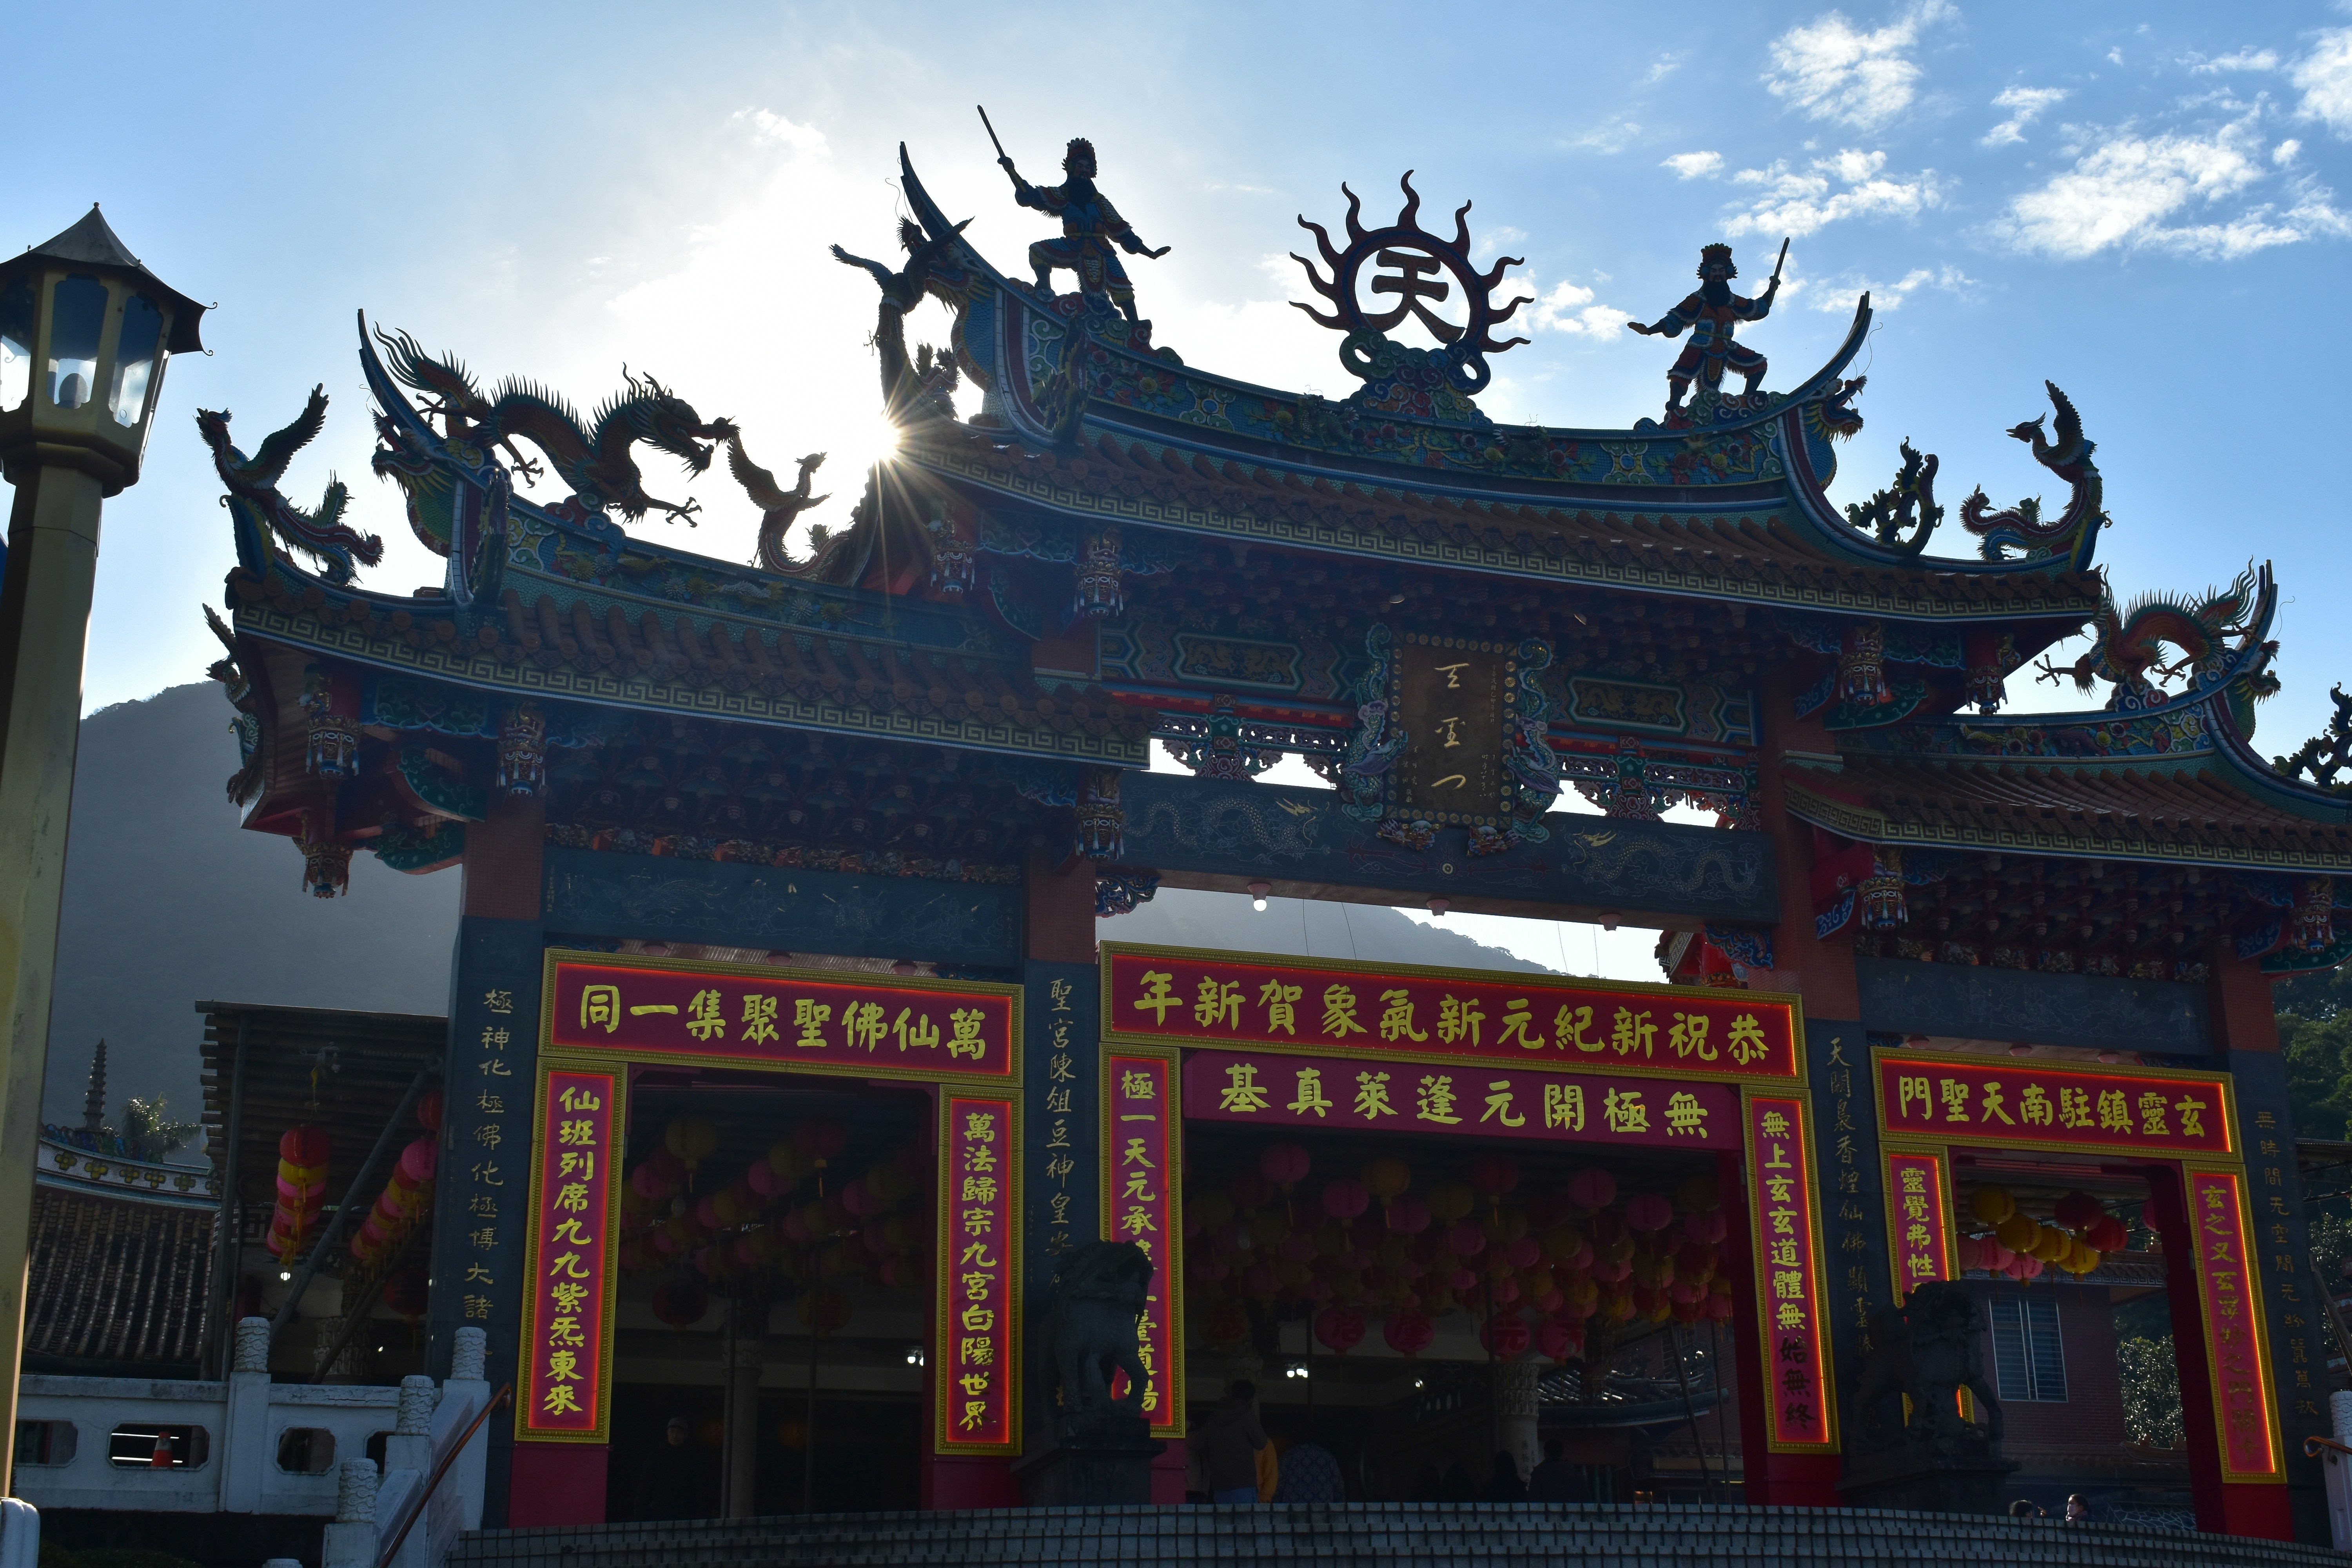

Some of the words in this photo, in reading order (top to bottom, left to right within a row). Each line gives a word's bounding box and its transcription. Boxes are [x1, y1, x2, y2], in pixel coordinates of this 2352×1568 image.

[581, 985, 985, 1059] 萬仙佛聖聚集一同
[1134, 970, 1768, 1065] 恭祝新紀元新氣象賀新年
[1220, 1064, 1708, 1138] 無極開元蓬萊真基
[1899, 1076, 2206, 1137] 玄靈鎮駐南天聖門
[463, 991, 513, 1355] 極神化極佛化極博大諸
[959, 1113, 997, 1431] 萬法歸宗九宮白陽世界
[1901, 1168, 1936, 1294] 靈覺弗性
